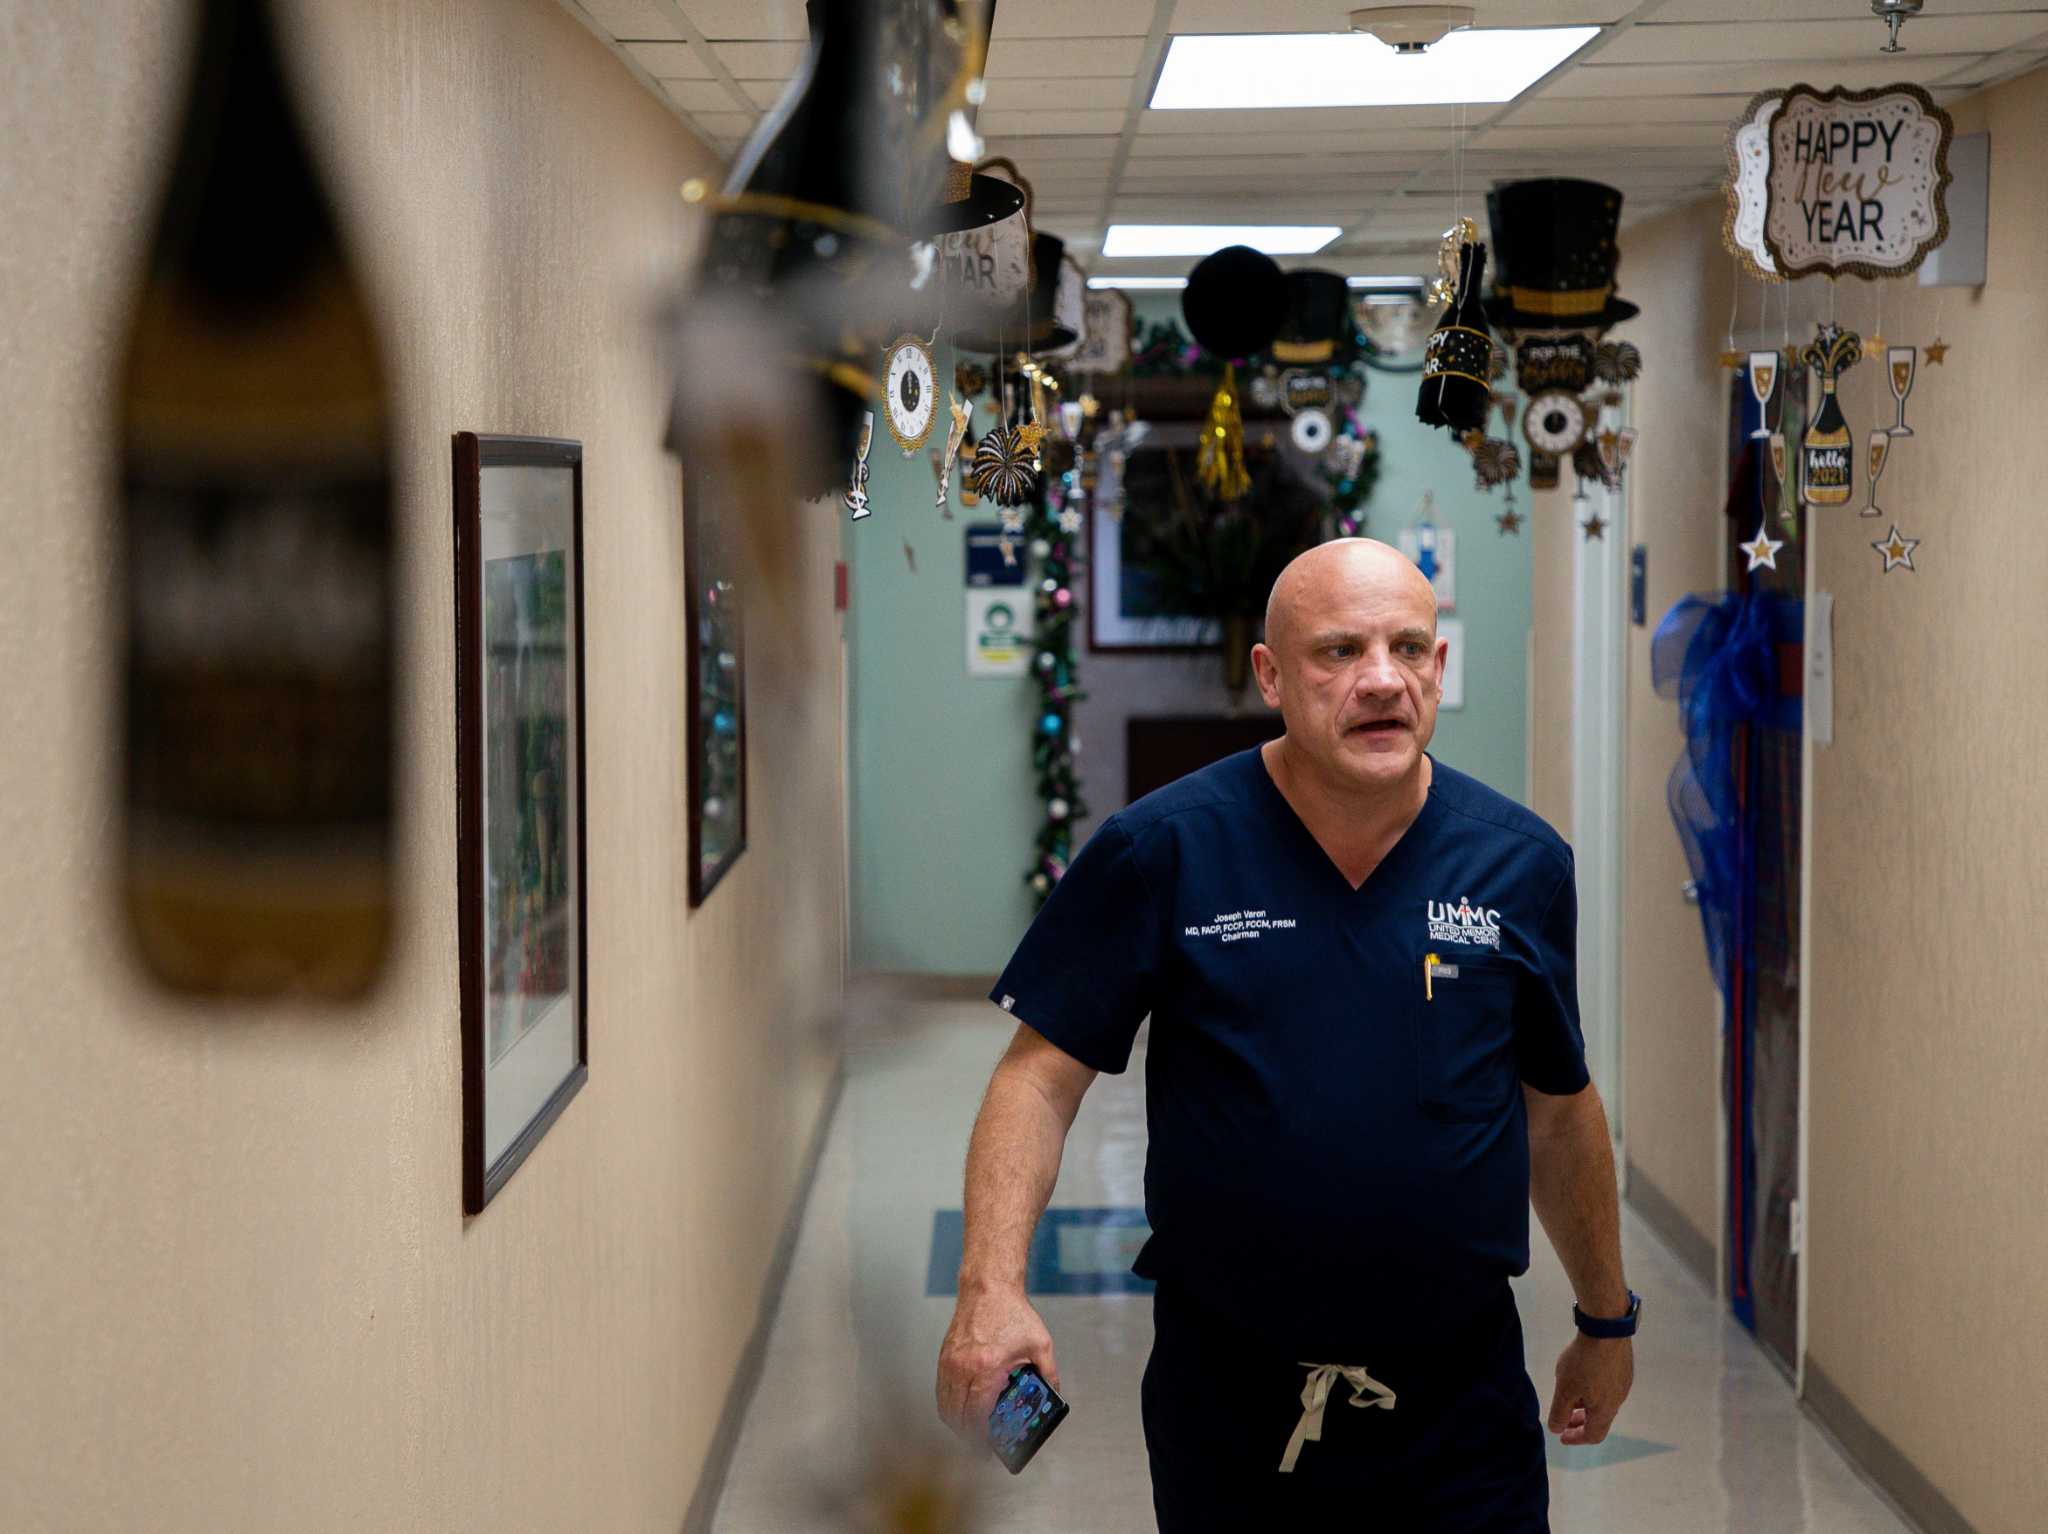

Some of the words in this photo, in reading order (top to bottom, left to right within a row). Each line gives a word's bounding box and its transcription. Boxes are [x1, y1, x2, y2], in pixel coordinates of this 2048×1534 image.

[1795, 119, 1904, 165] HAPPY
[1801, 199, 1884, 242] YEAR
[1809, 450, 1846, 468] hello
[1214, 912, 1242, 923] Joseph
[1243, 909, 1266, 919] Varon
[1428, 900, 1501, 930] UMMC
[1185, 926, 1200, 936] MD,
[1201, 925, 1222, 935] FACP,
[1223, 921, 1245, 932] FCCP,
[1246, 919, 1271, 929] FCCM,
[1221, 930, 1260, 942] Chairman
[1429, 932, 1471, 945] MEDICAL
